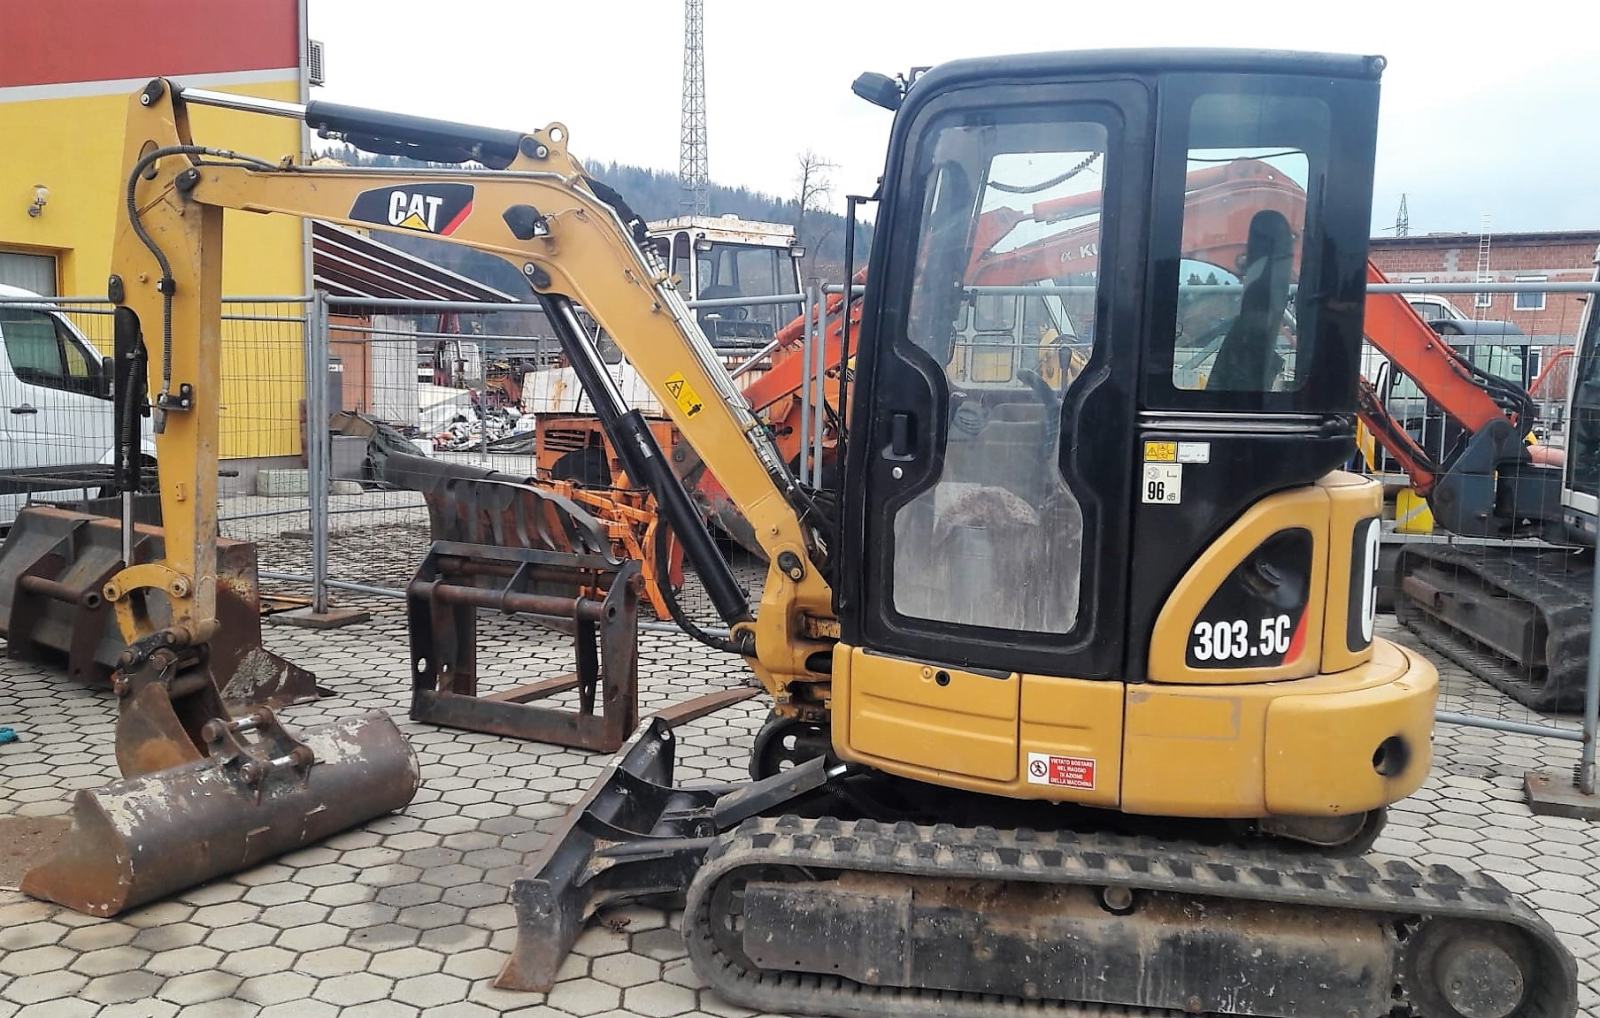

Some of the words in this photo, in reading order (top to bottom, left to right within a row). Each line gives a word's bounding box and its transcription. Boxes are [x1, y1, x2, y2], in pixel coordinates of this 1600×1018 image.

[388, 191, 443, 232] CAT
[1148, 481, 1164, 500] 96
[1194, 614, 1290, 660] 303.5C
[1067, 779, 1092, 787] MACCHINA
